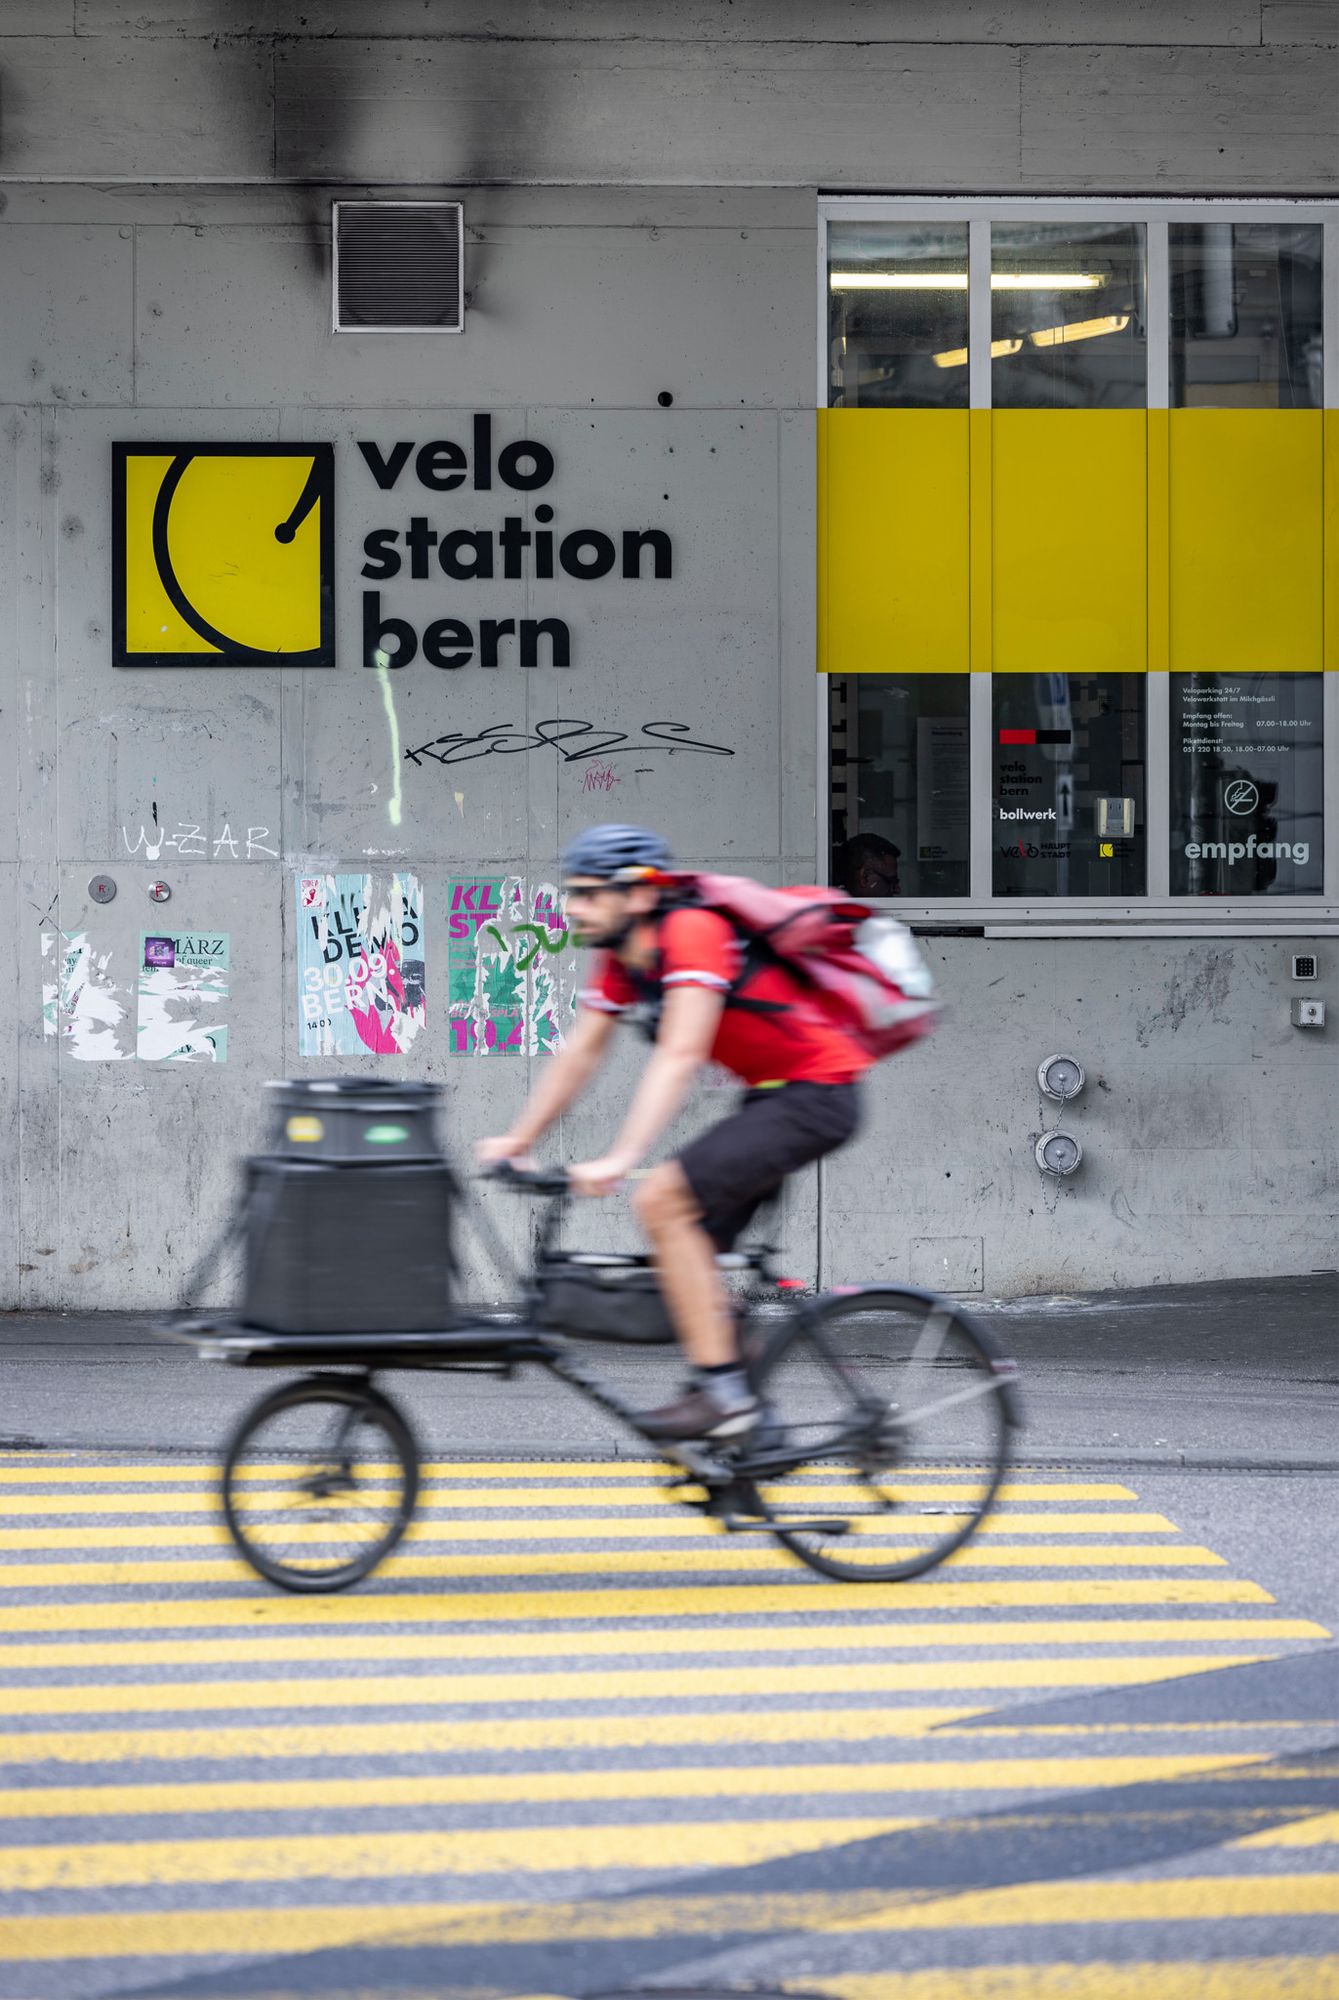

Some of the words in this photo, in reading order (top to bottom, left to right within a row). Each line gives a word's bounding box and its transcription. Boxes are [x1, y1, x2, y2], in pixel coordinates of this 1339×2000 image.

[357, 413, 554, 491] velo
[361, 504, 673, 581] station
[363, 591, 571, 669] bern
[1183, 687, 1222, 695] Veloparking
[1183, 712, 1212, 720] Empfang
[1221, 720, 1244, 728] Freitag
[1000, 761, 1026, 772] velo
[1000, 773, 1042, 783] station
[1000, 785, 1029, 795] bern
[1000, 808, 1056, 820] bollwerk
[1184, 834, 1309, 865] empfang
[303, 953, 395, 992] 30.09.
